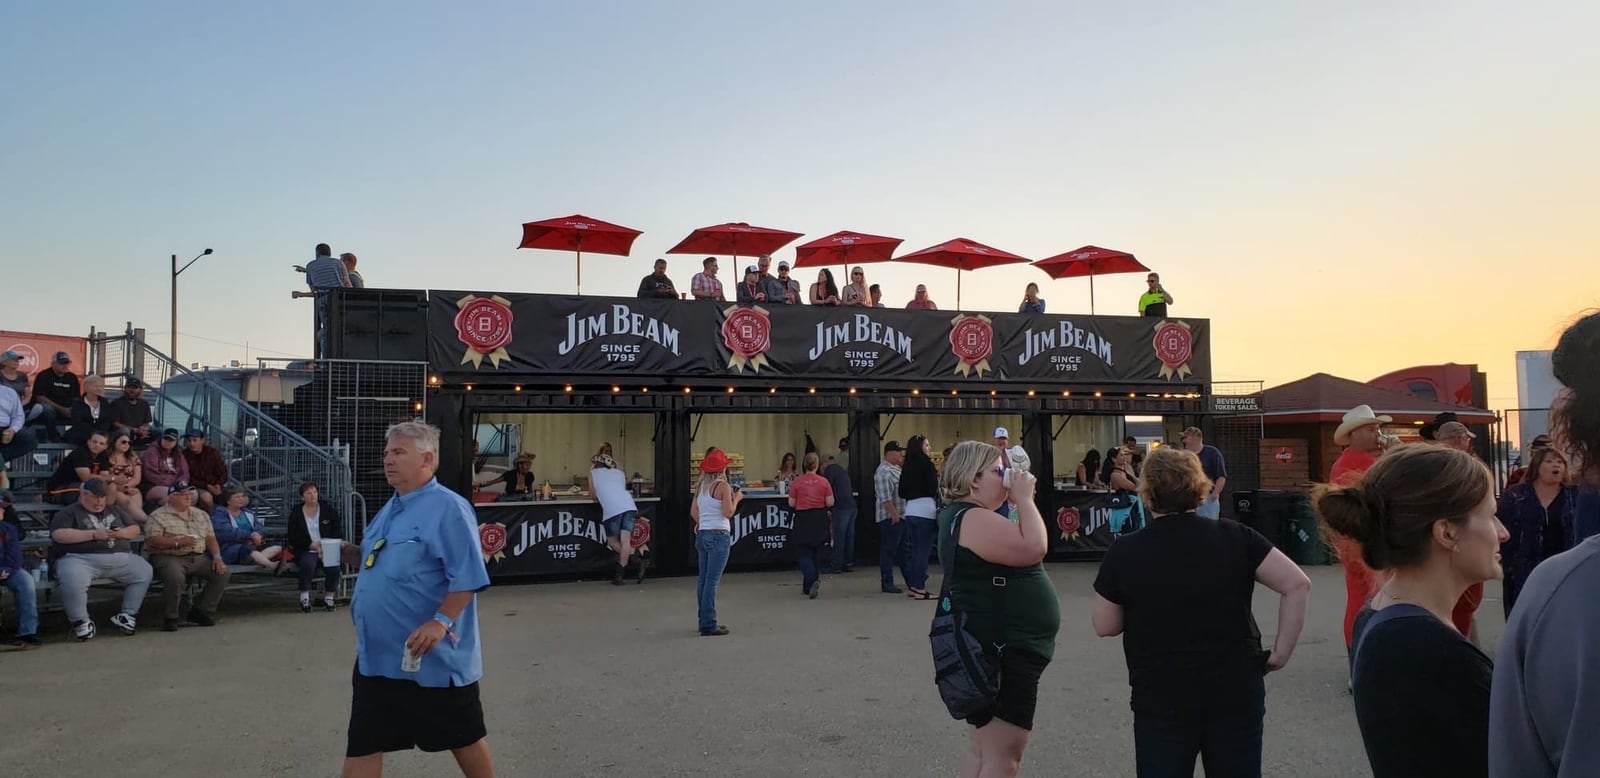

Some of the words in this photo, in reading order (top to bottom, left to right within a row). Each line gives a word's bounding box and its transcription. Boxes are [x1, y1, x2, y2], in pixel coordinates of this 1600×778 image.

[558, 312, 608, 355] JIM
[611, 304, 680, 357] BEAM
[809, 321, 850, 361] JIM
[853, 313, 912, 363] BEAM
[1018, 328, 1056, 365] JIM
[1059, 320, 1113, 367] BEAM
[600, 344, 641, 353] SINCE
[606, 353, 636, 362] 1795
[844, 350, 879, 359] SINCE
[1050, 355, 1082, 363] SINCE
[849, 359, 874, 367] 1795
[1055, 363, 1078, 371] 1795
[1084, 505, 1113, 536] JIM
[729, 512, 763, 546] JIM
[513, 518, 554, 556] JIM
[757, 534, 787, 542] SINCE
[547, 543, 581, 552] SINCE
[762, 541, 783, 549] 1795
[553, 551, 577, 559] 1795
